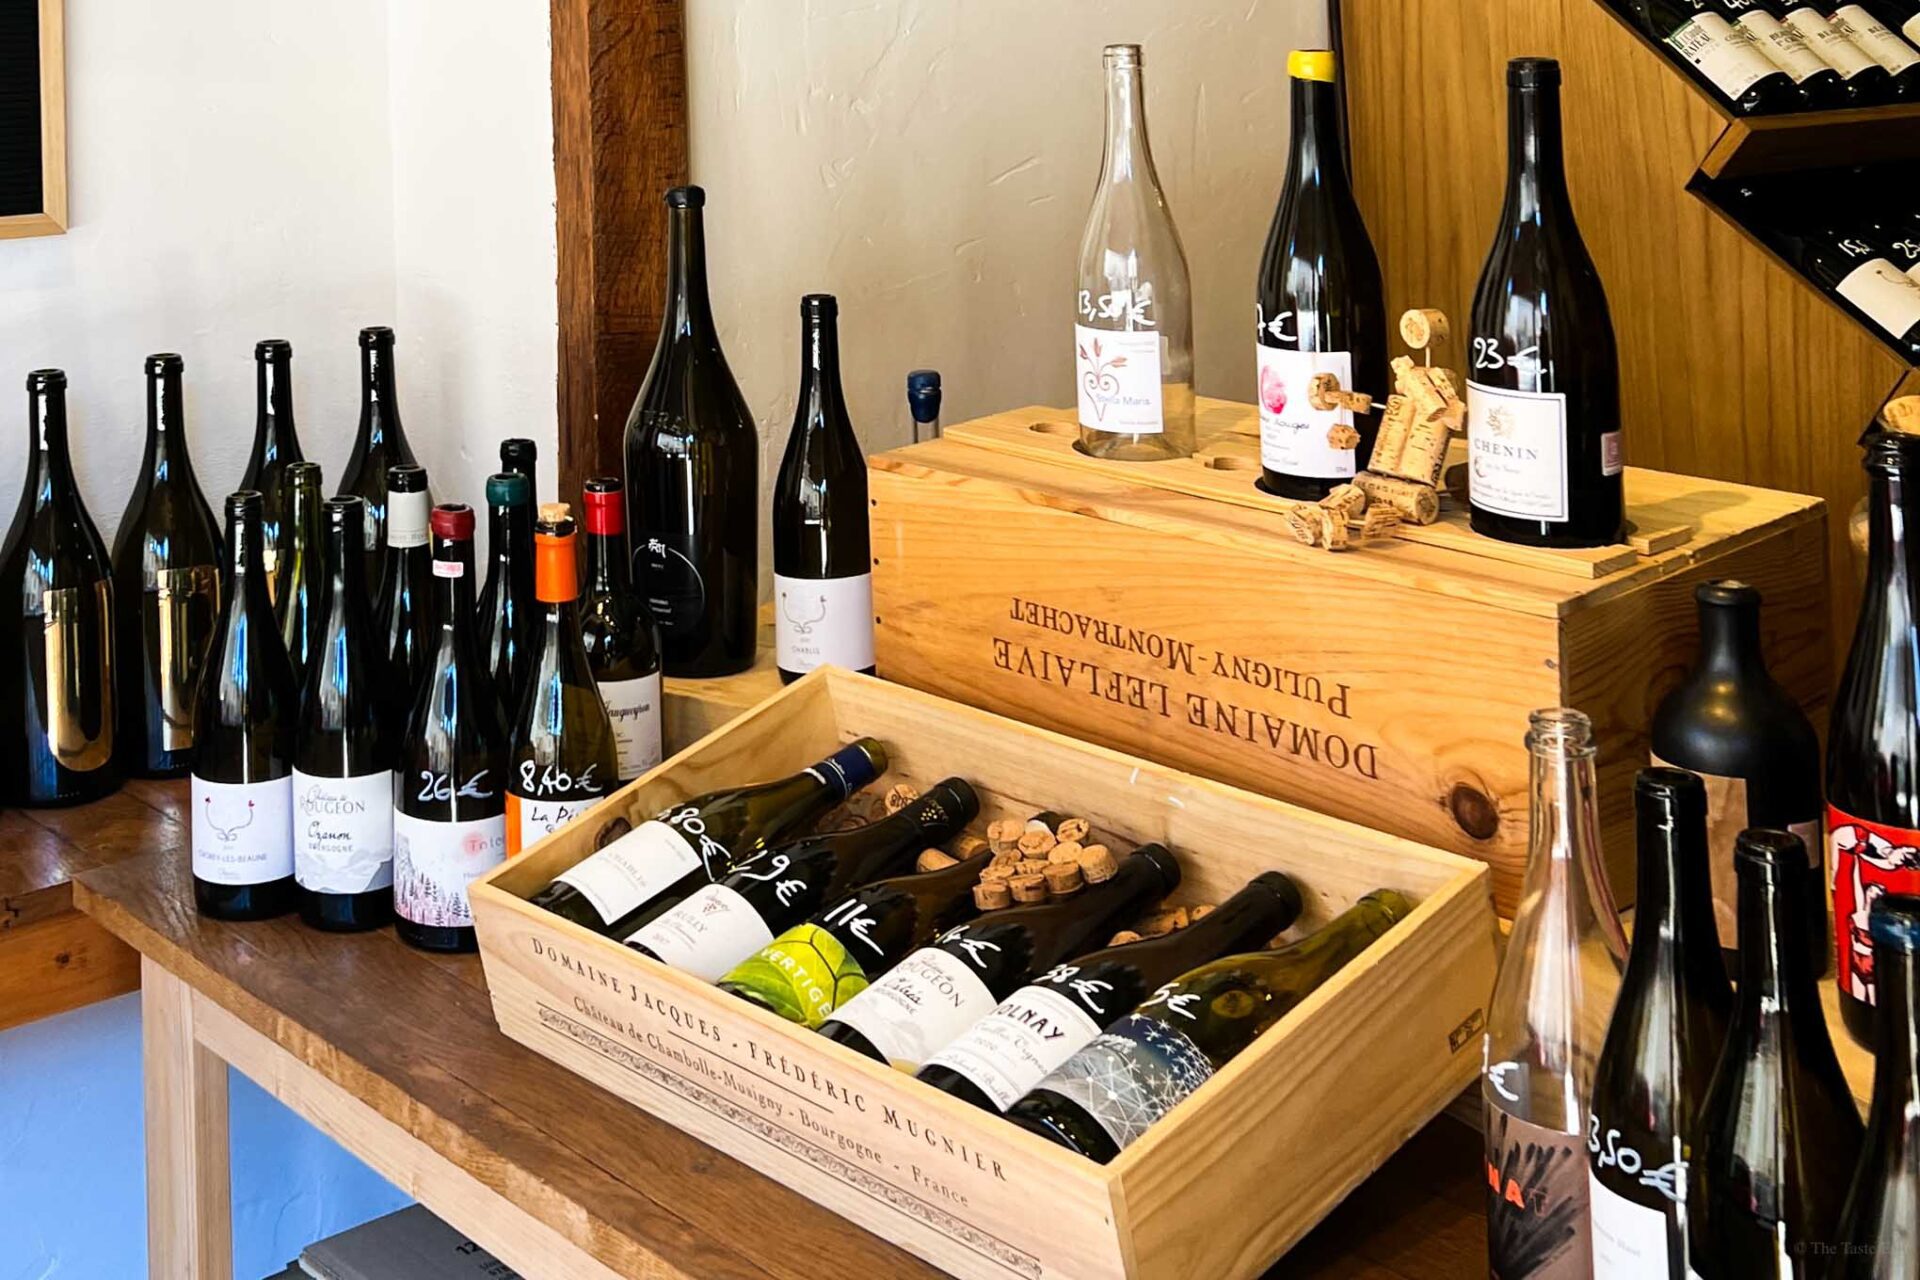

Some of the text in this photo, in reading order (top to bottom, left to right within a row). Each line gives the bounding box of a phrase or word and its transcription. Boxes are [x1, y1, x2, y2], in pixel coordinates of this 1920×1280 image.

[1473, 437, 1539, 461] CHENIN
[993, 637, 1380, 780] DOMAINE LEFLAIVE
[532, 807, 548, 821] La
[761, 949, 833, 1018] VERTIGE
[531, 937, 622, 994] DOMAINE
[630, 984, 722, 1042] JACQUES
[747, 1040, 867, 1113] FRÉDÉRIC
[881, 1105, 1008, 1182] MUGNIER
[573, 996, 624, 1034] Château
[628, 1023, 643, 1043] de
[647, 1033, 783, 1117] Chambolle-Musigny
[799, 1108, 883, 1165] Bourgogne
[911, 1164, 970, 1208] France
